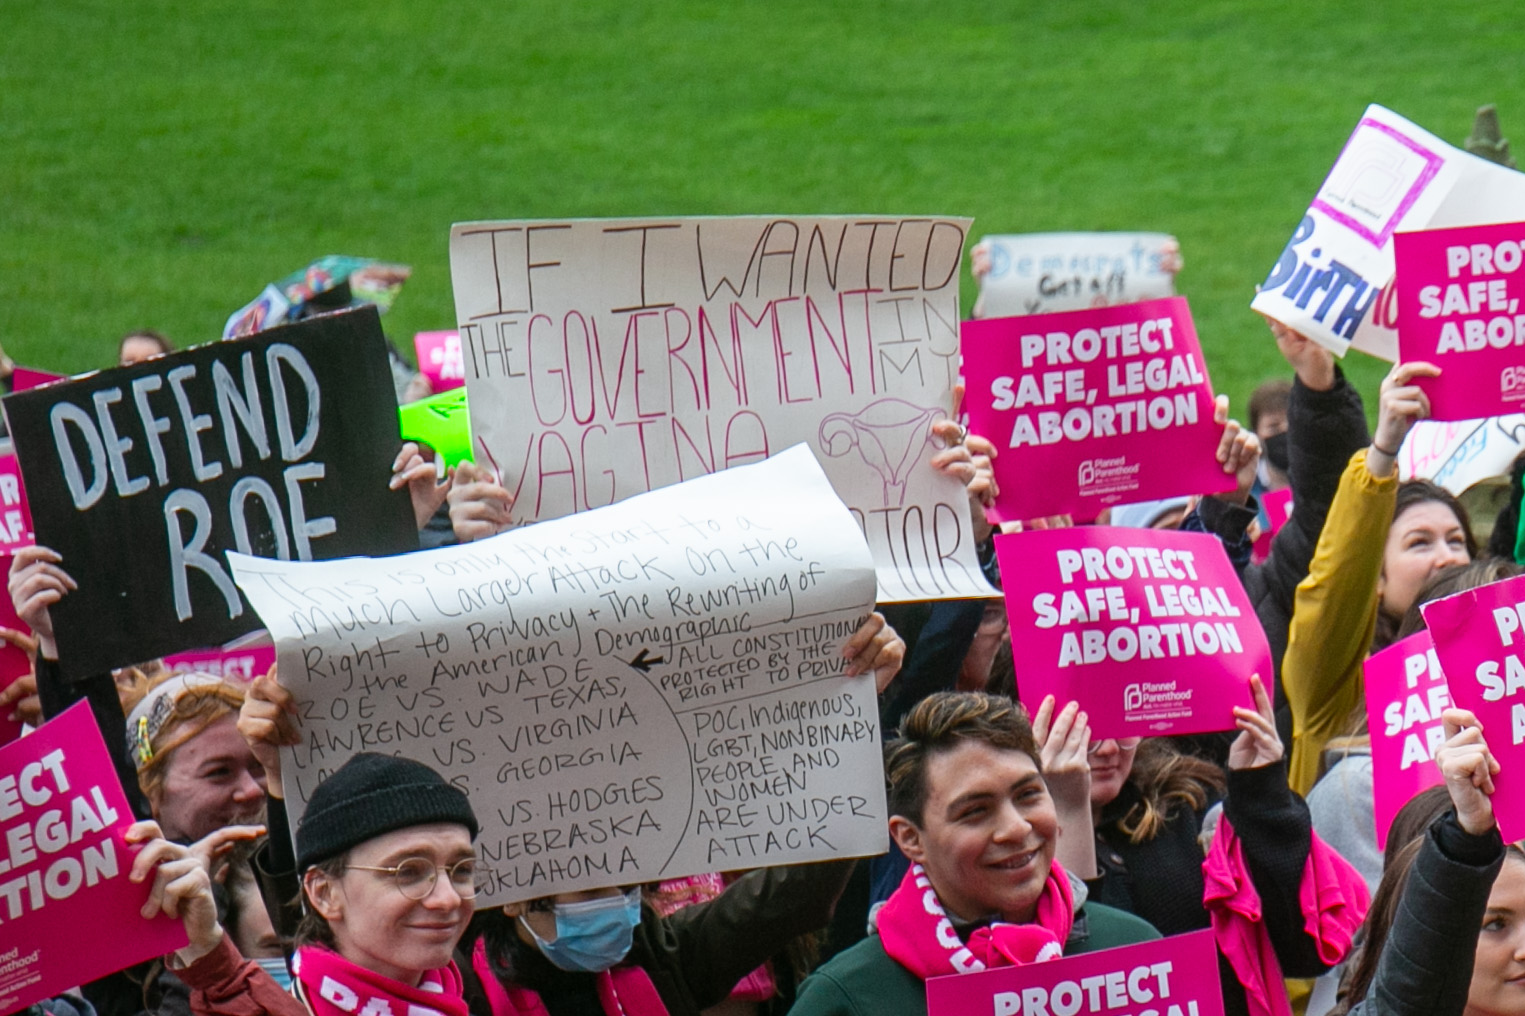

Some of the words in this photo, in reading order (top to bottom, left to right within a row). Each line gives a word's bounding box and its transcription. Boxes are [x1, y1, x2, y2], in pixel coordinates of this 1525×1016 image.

[461, 224, 572, 321] IF
[603, 224, 682, 314] I
[696, 219, 964, 301] WANTED
[1419, 280, 1521, 318] SAFE,
[460, 319, 525, 380] THE
[527, 289, 883, 426] GOVERNMENT
[876, 296, 958, 345] IN
[1020, 316, 1174, 369] PROTECT
[878, 345, 958, 392] MY
[991, 369, 1099, 411] SAFE,
[1107, 352, 1205, 398] LEGAL
[50, 343, 322, 511] DEFEND
[1009, 392, 1199, 449] ABORTION
[477, 410, 769, 518] VAGINA
[739, 537, 803, 567] the
[1057, 545, 1199, 585] PROTECT
[302, 636, 401, 692] Right
[415, 631, 450, 658] to
[466, 605, 583, 657] Privacy
[667, 571, 797, 623] Rewriting
[798, 560, 826, 591] of
[1032, 586, 1141, 630] SAFE,
[1144, 584, 1241, 618] LEGAL
[359, 673, 408, 696] the
[430, 640, 564, 686] American
[594, 611, 753, 664] Demographic
[660, 656, 760, 691] PROTECTED
[768, 652, 790, 668] BY
[796, 642, 837, 661] THE
[678, 645, 723, 668] ALL
[1058, 621, 1244, 669] ABORTION
[478, 658, 593, 698] WADE
[678, 674, 751, 703] RIGHT
[766, 666, 790, 685] TO
[797, 656, 851, 680] PRIVA
[291, 712, 456, 770] LAWRENCE
[464, 704, 505, 730] VS
[523, 676, 627, 715] TEXAS,
[498, 702, 639, 753] VIRGINIA
[496, 742, 642, 785] GEORGIA
[792, 748, 840, 773] AND
[548, 776, 664, 821] HODGES
[704, 770, 807, 807] WOMEN
[480, 809, 663, 863] NEBRASKA
[696, 804, 758, 835] ARE
[766, 794, 876, 826] UNDER
[706, 824, 838, 864] ATTACK
